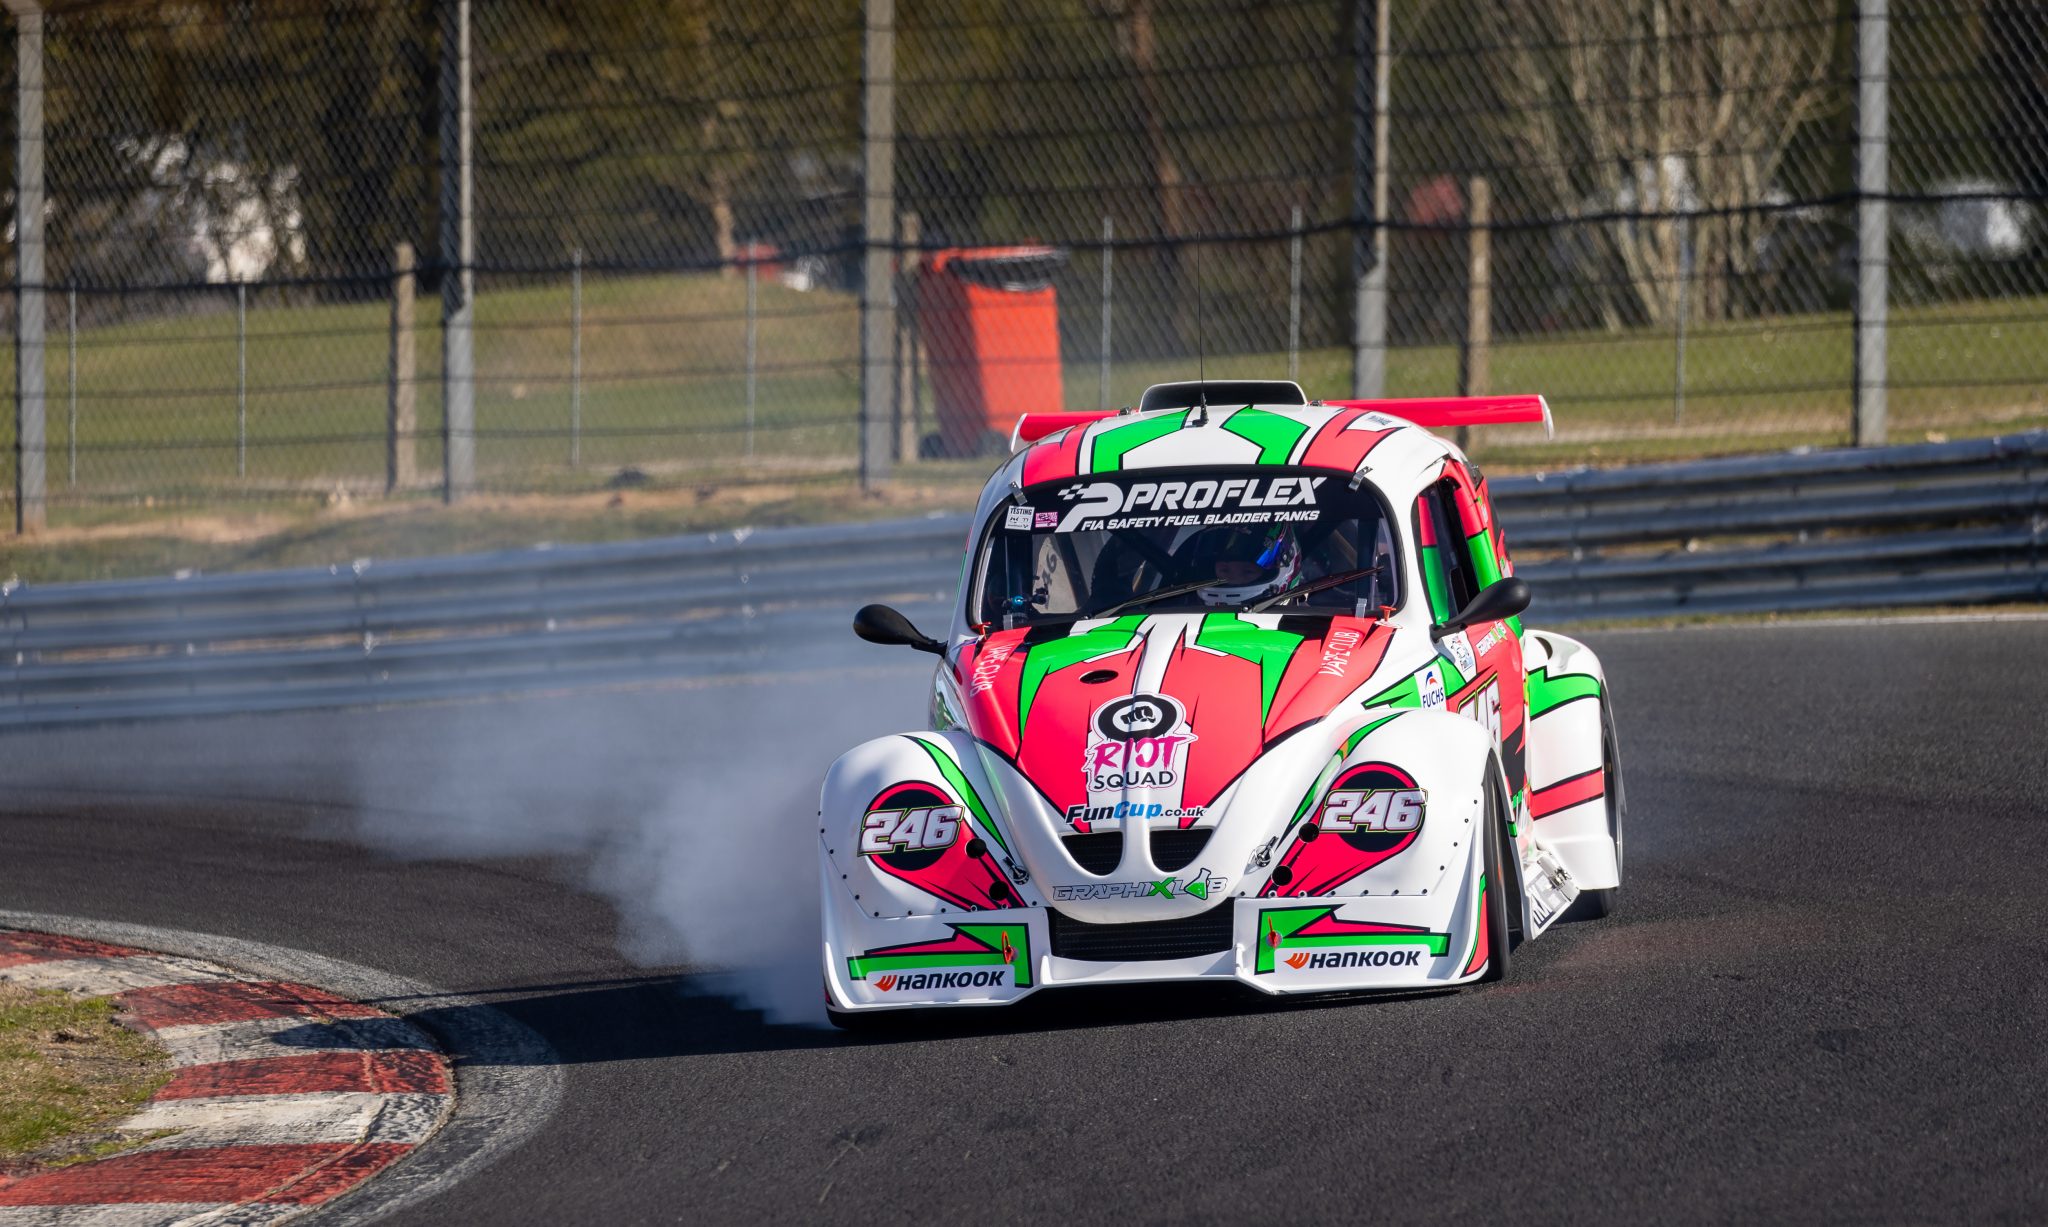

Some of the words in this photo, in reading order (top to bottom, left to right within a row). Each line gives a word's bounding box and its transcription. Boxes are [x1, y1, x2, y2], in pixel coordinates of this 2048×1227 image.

[1122, 476, 1327, 512] PROFLEX
[1081, 520, 1104, 531] FIA
[1106, 516, 1165, 530] SAFETY
[1164, 513, 1201, 527] FUEL
[1203, 511, 1272, 525] BLADDER
[1274, 510, 1320, 522] TANKS
[1328, 631, 1360, 651] CLUB
[1318, 651, 1351, 678] VAPE
[1422, 687, 1445, 708] FUCHS
[1093, 735, 1188, 778] RIOT
[1093, 771, 1174, 790] SQUAD
[1319, 787, 1429, 833] 246
[858, 803, 965, 857] 246
